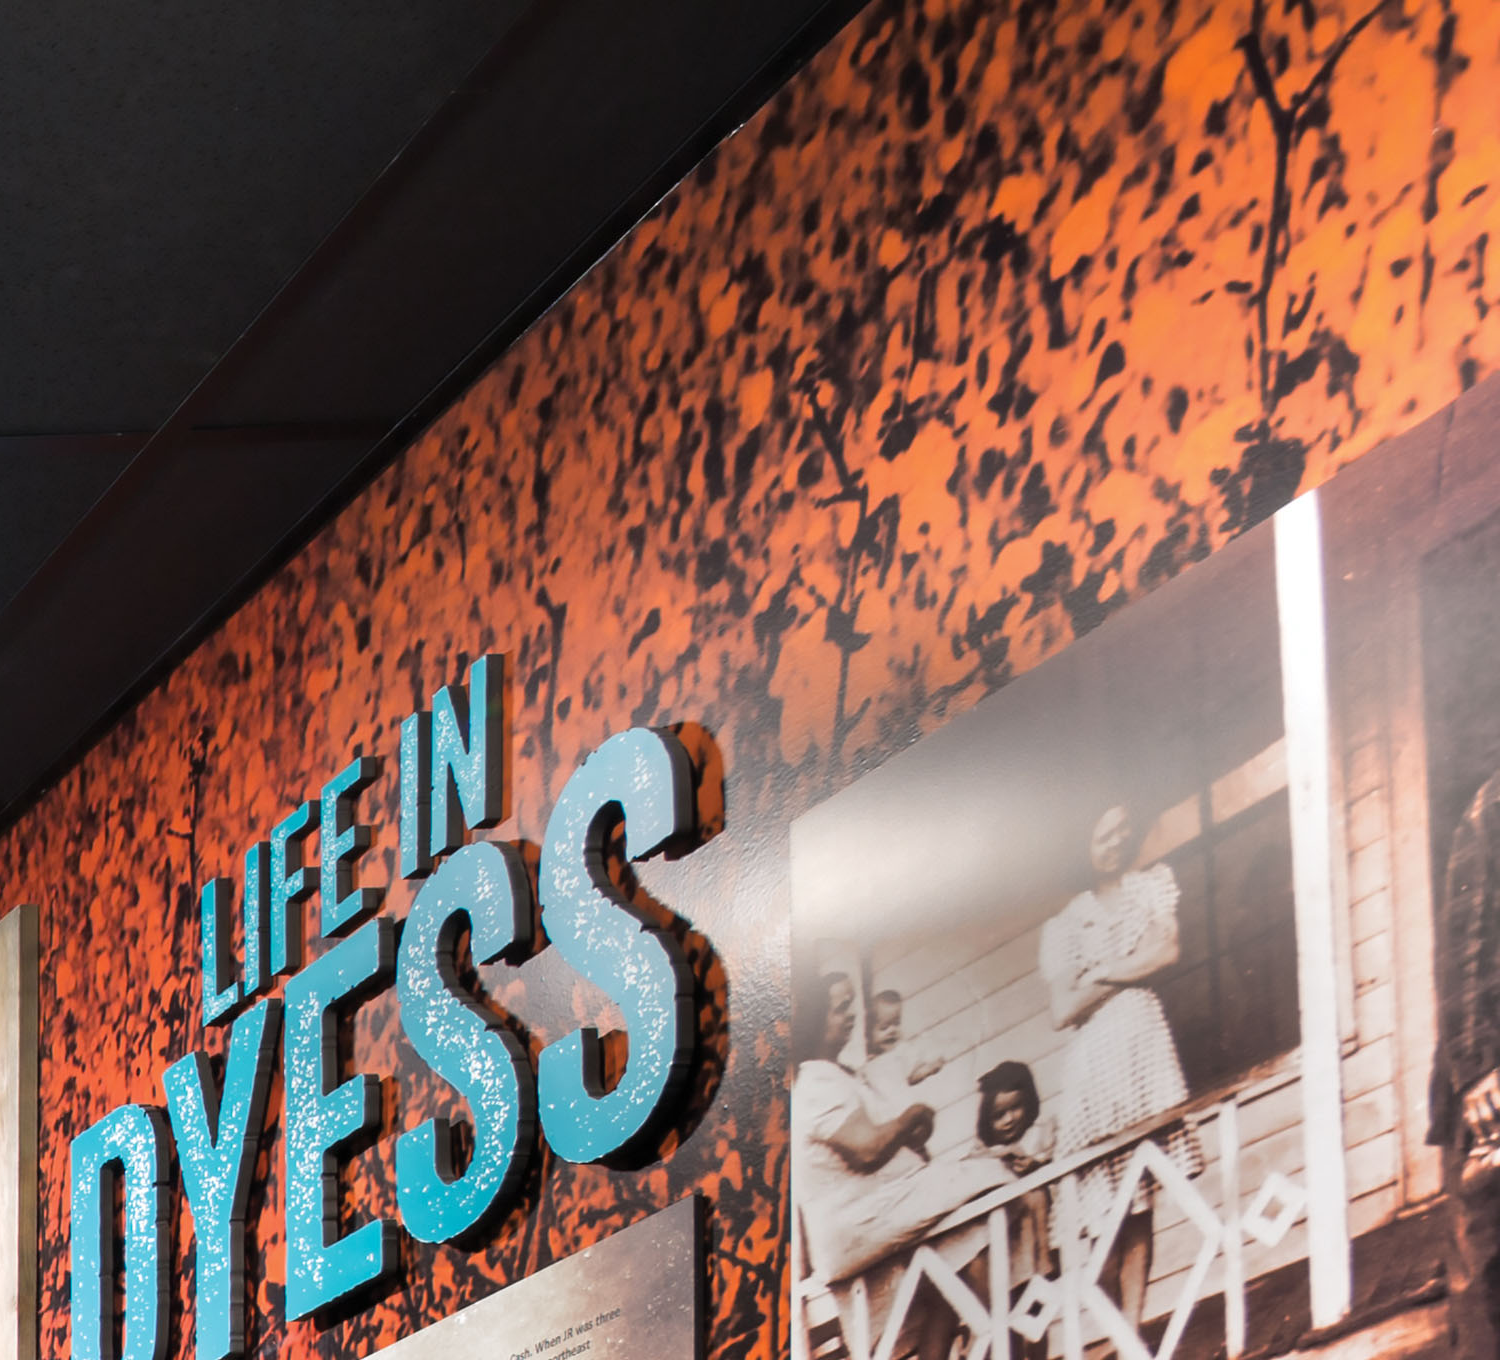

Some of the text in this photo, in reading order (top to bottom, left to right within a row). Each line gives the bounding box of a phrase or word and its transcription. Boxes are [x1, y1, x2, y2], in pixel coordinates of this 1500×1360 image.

[201, 653, 504, 1027] LIFE IN
[535, 1336, 561, 1355] When
[563, 1328, 572, 1343] JR
[575, 1321, 592, 1337] was
[595, 1308, 622, 1328] three
